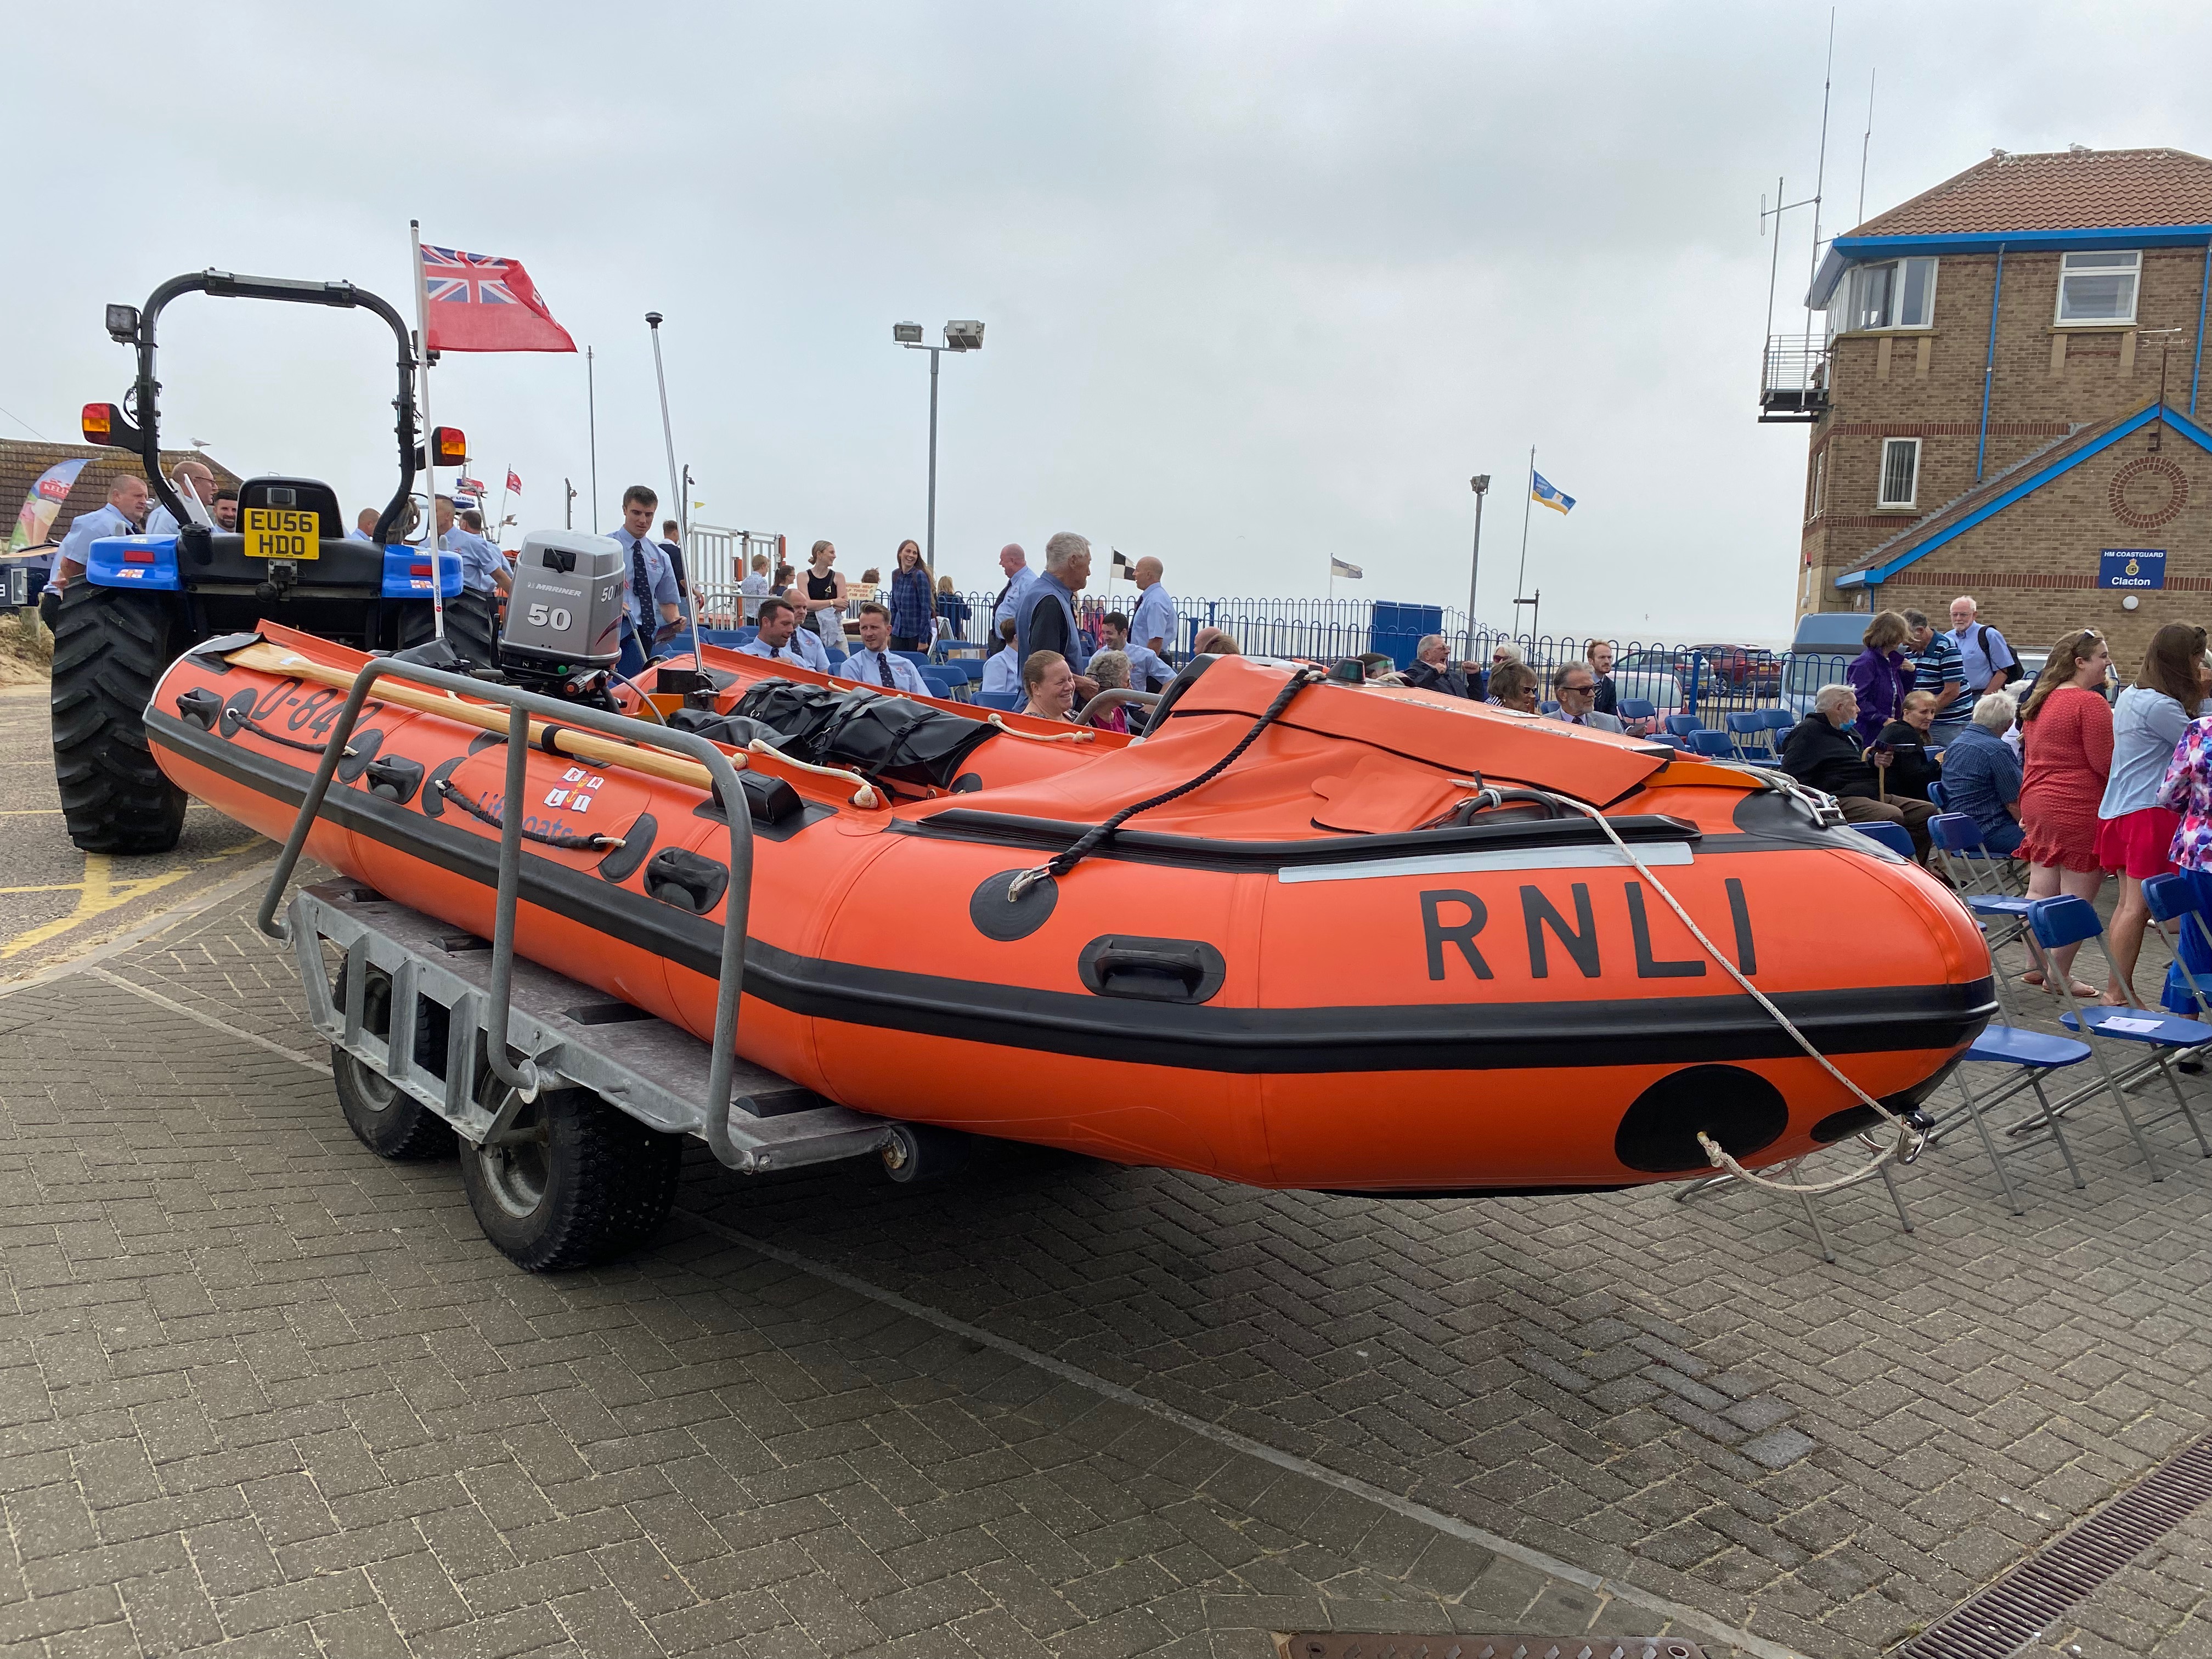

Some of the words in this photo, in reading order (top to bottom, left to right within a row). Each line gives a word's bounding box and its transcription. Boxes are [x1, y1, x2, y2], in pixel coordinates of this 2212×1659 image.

[251, 511, 313, 533] EU56
[259, 534, 305, 555] HDO
[535, 583, 582, 597] MARINER
[2111, 577, 2151, 586] Clacton
[601, 585, 614, 602] 50
[527, 603, 572, 631] 50
[1419, 878, 1757, 980] RNLI
